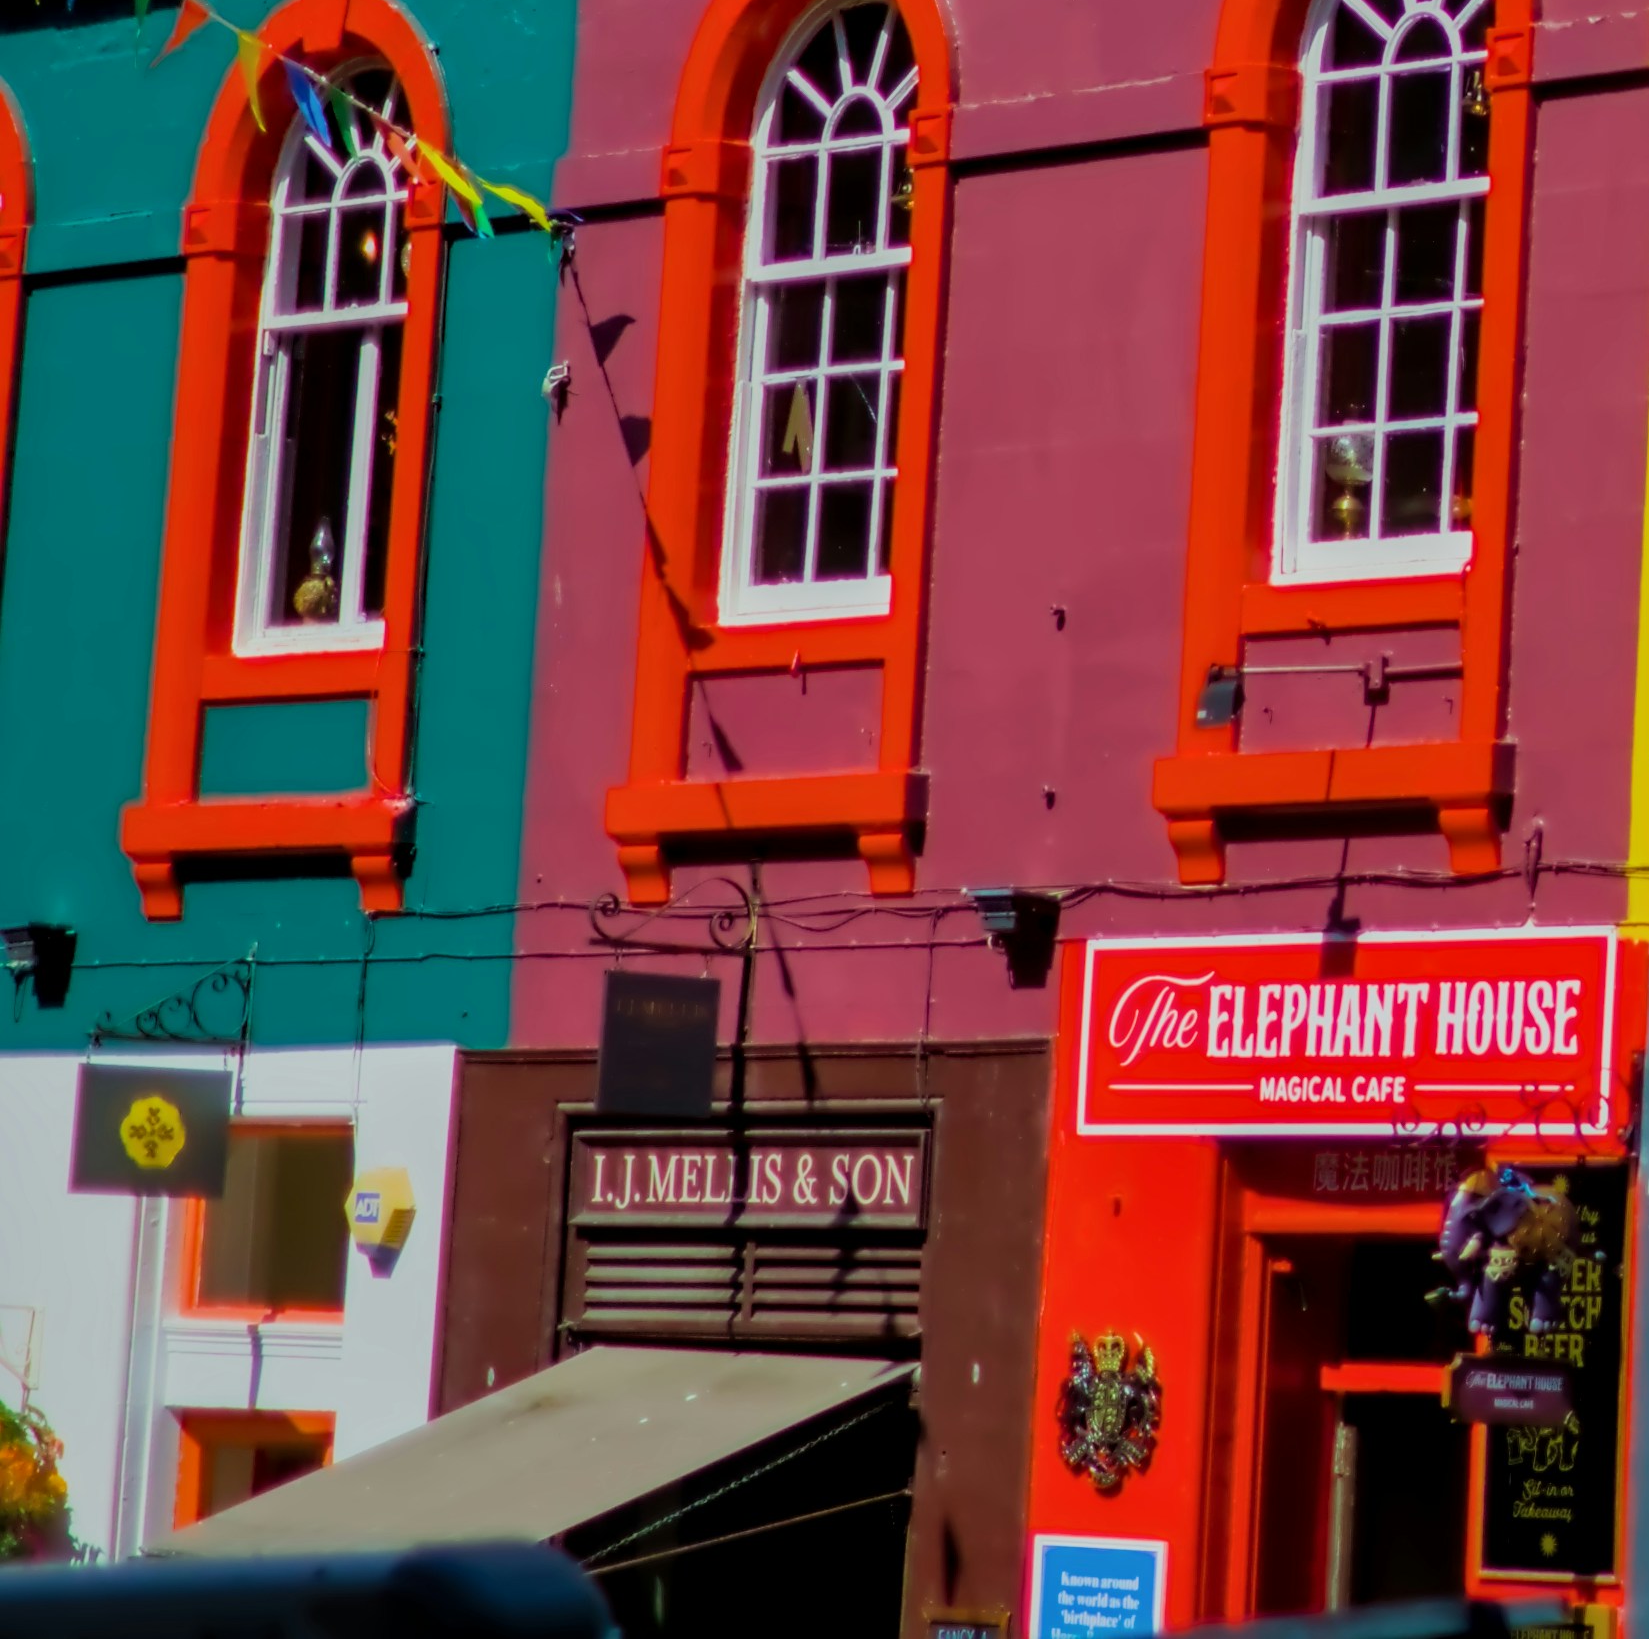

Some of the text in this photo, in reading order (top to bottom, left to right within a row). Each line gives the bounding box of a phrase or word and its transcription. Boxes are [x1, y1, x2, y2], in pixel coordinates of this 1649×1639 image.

[1108, 971, 1581, 1066] The ELEPHANT HOUSE
[1259, 1076, 1406, 1104] MAGICAL CAFE
[645, 1154, 783, 1205] MELLIS
[793, 1154, 818, 1204] &
[829, 1154, 915, 1206] SON
[355, 1197, 379, 1218] ADT
[1487, 1372, 1533, 1390] ELEPHANT
[1535, 1376, 1564, 1391] HOUSE
[1061, 1571, 1139, 1591] Known around
[1058, 1590, 1140, 1610] the world as the
[1124, 1615, 1136, 1629] of
